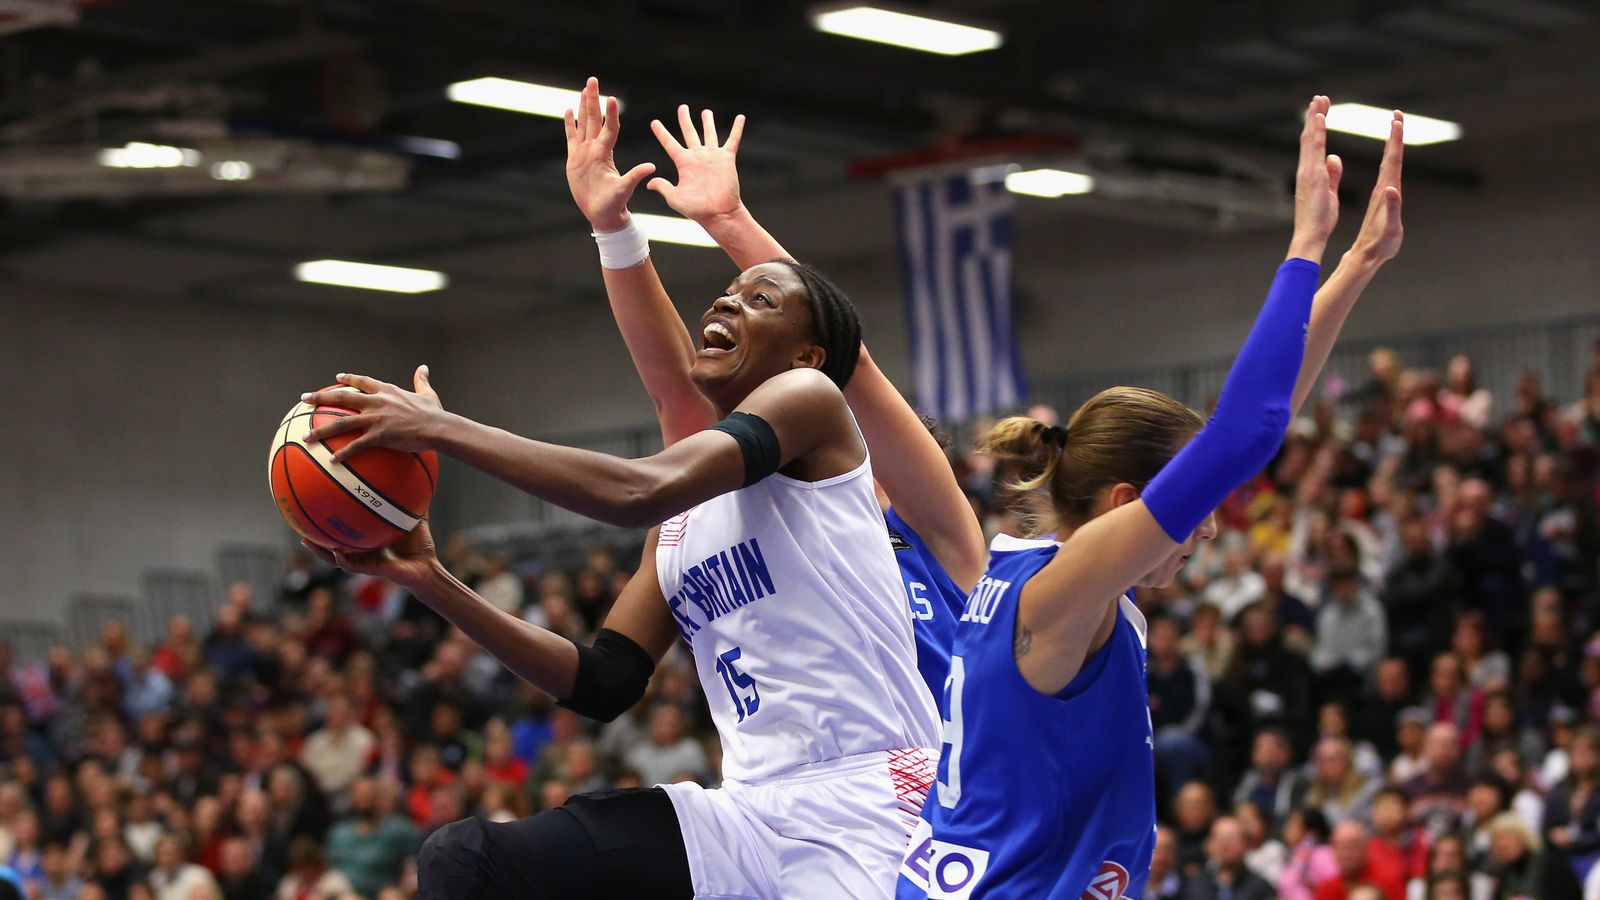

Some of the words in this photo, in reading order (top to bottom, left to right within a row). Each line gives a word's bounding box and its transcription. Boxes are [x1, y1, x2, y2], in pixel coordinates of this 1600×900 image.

[354, 485, 382, 508] GL6X
[682, 537, 776, 622] BRITAIN
[716, 646, 760, 723] 15
